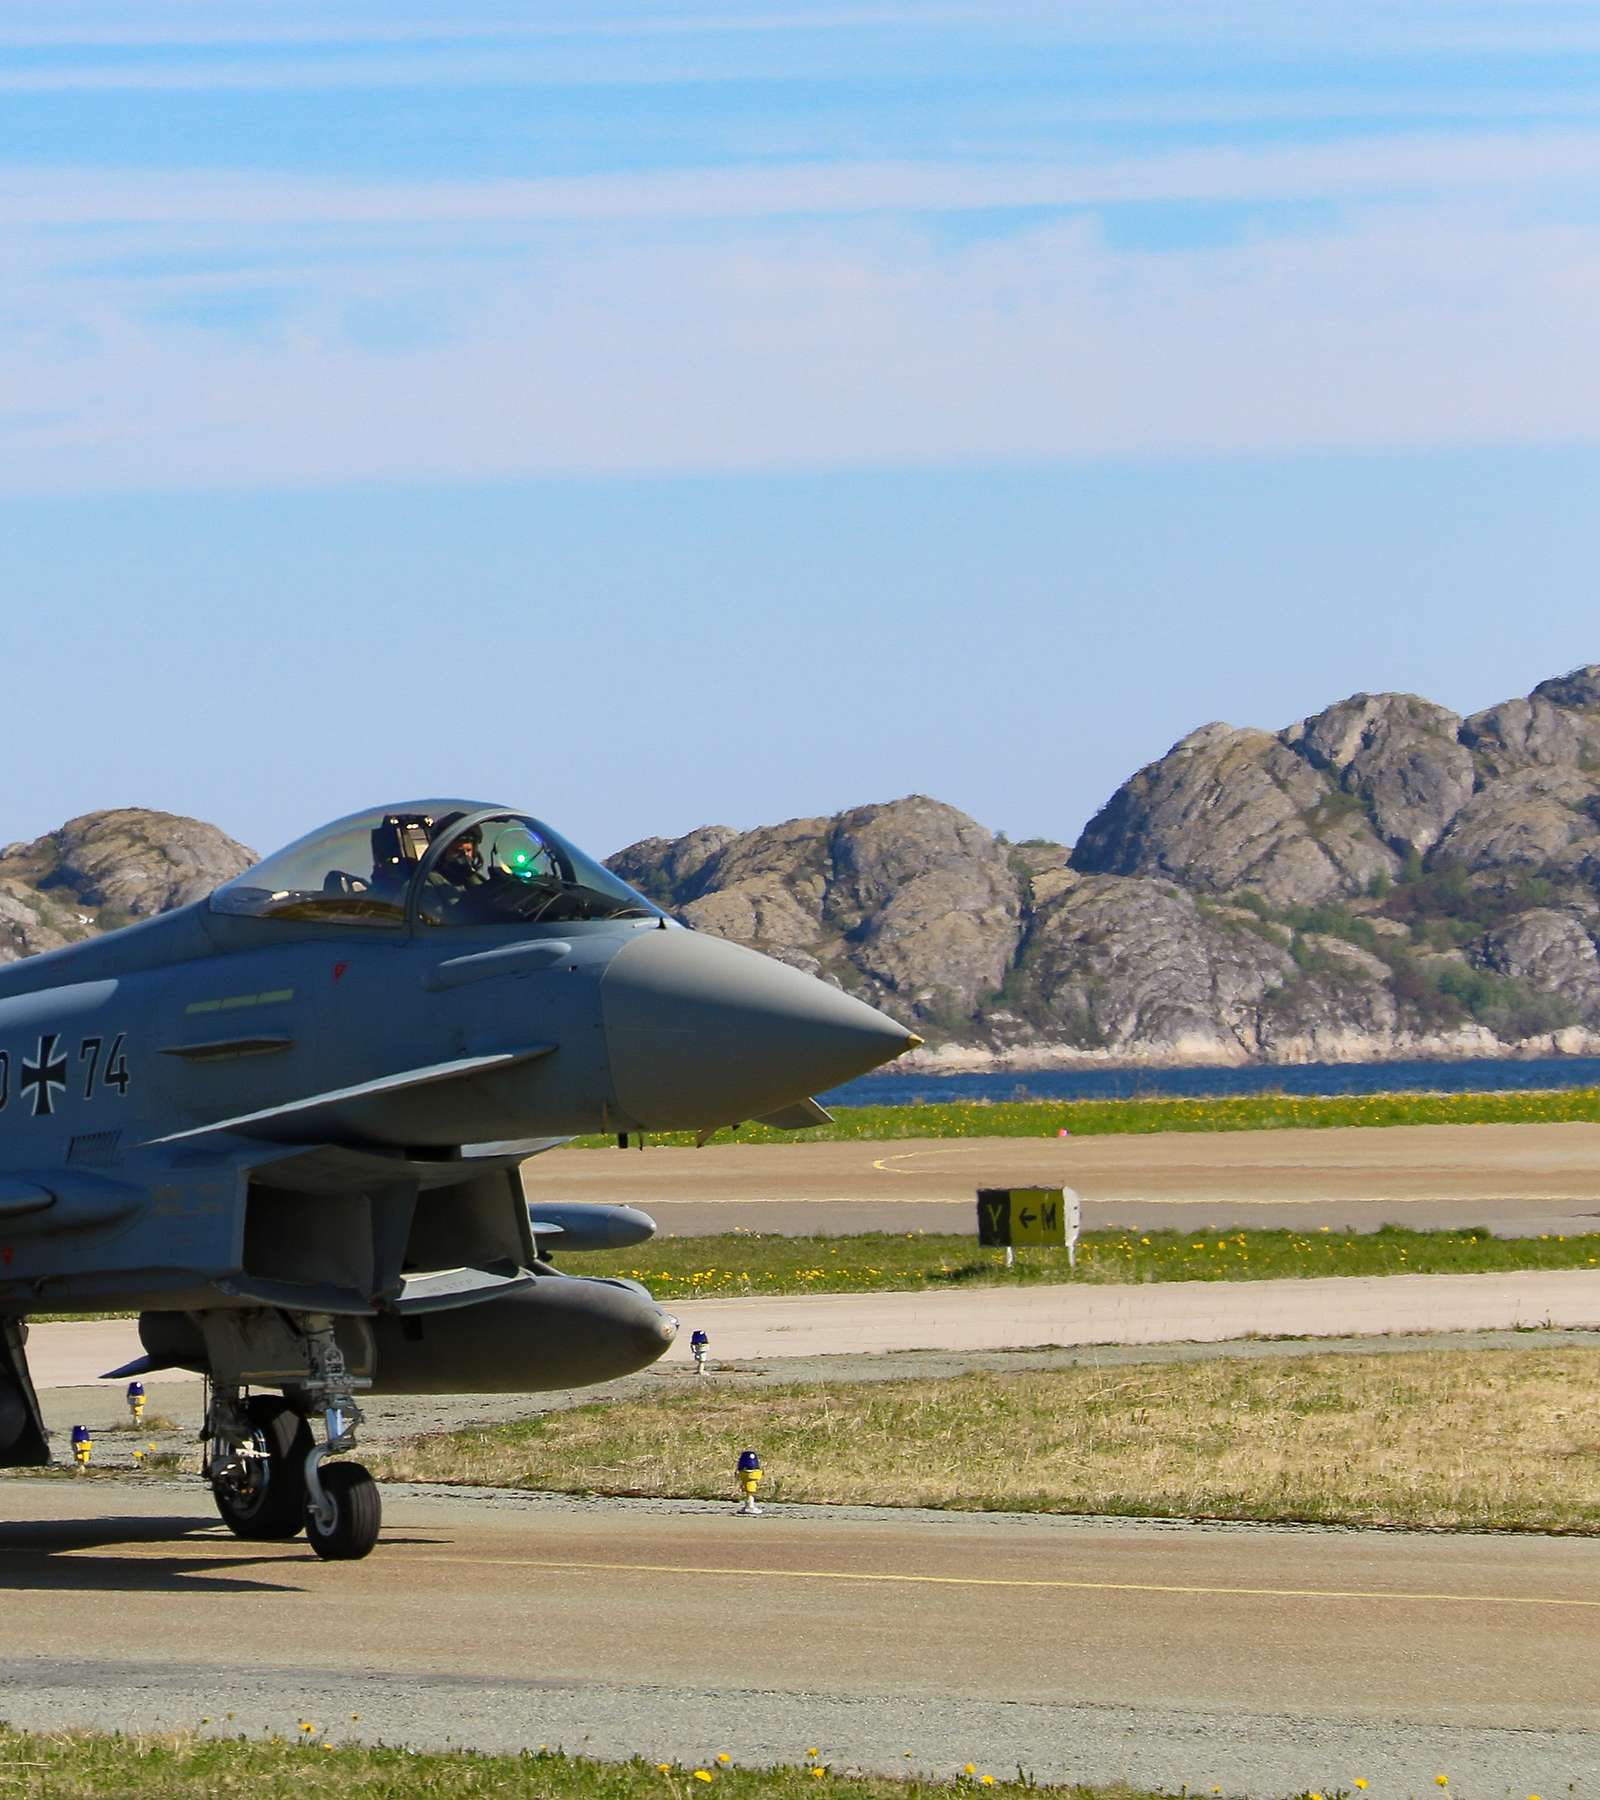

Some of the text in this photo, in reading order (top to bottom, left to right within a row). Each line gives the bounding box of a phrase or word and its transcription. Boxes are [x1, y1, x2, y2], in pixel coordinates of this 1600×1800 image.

[77, 1032, 131, 1100] 74
[986, 1203, 1057, 1232] Y M
